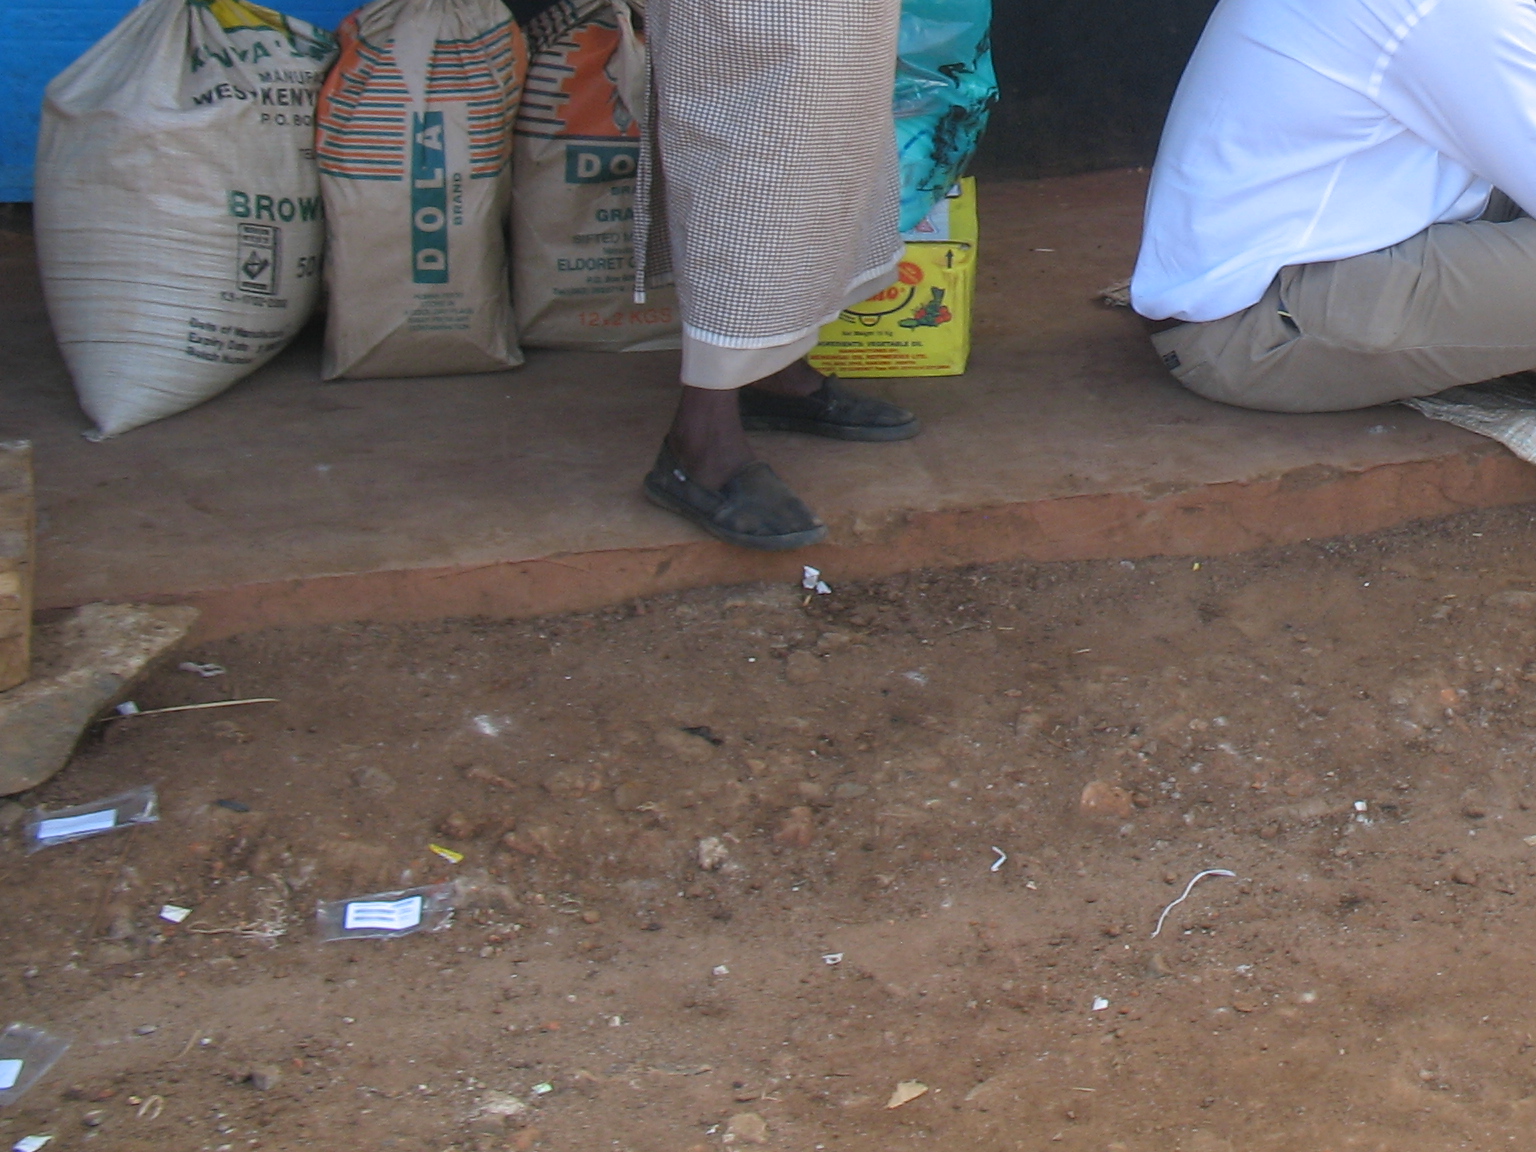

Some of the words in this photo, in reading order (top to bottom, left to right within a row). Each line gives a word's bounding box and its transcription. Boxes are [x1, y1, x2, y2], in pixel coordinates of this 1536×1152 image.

[414, 124, 446, 271] DOLA
[453, 172, 463, 225] BRAND
[557, 256, 624, 271] ELDORET
